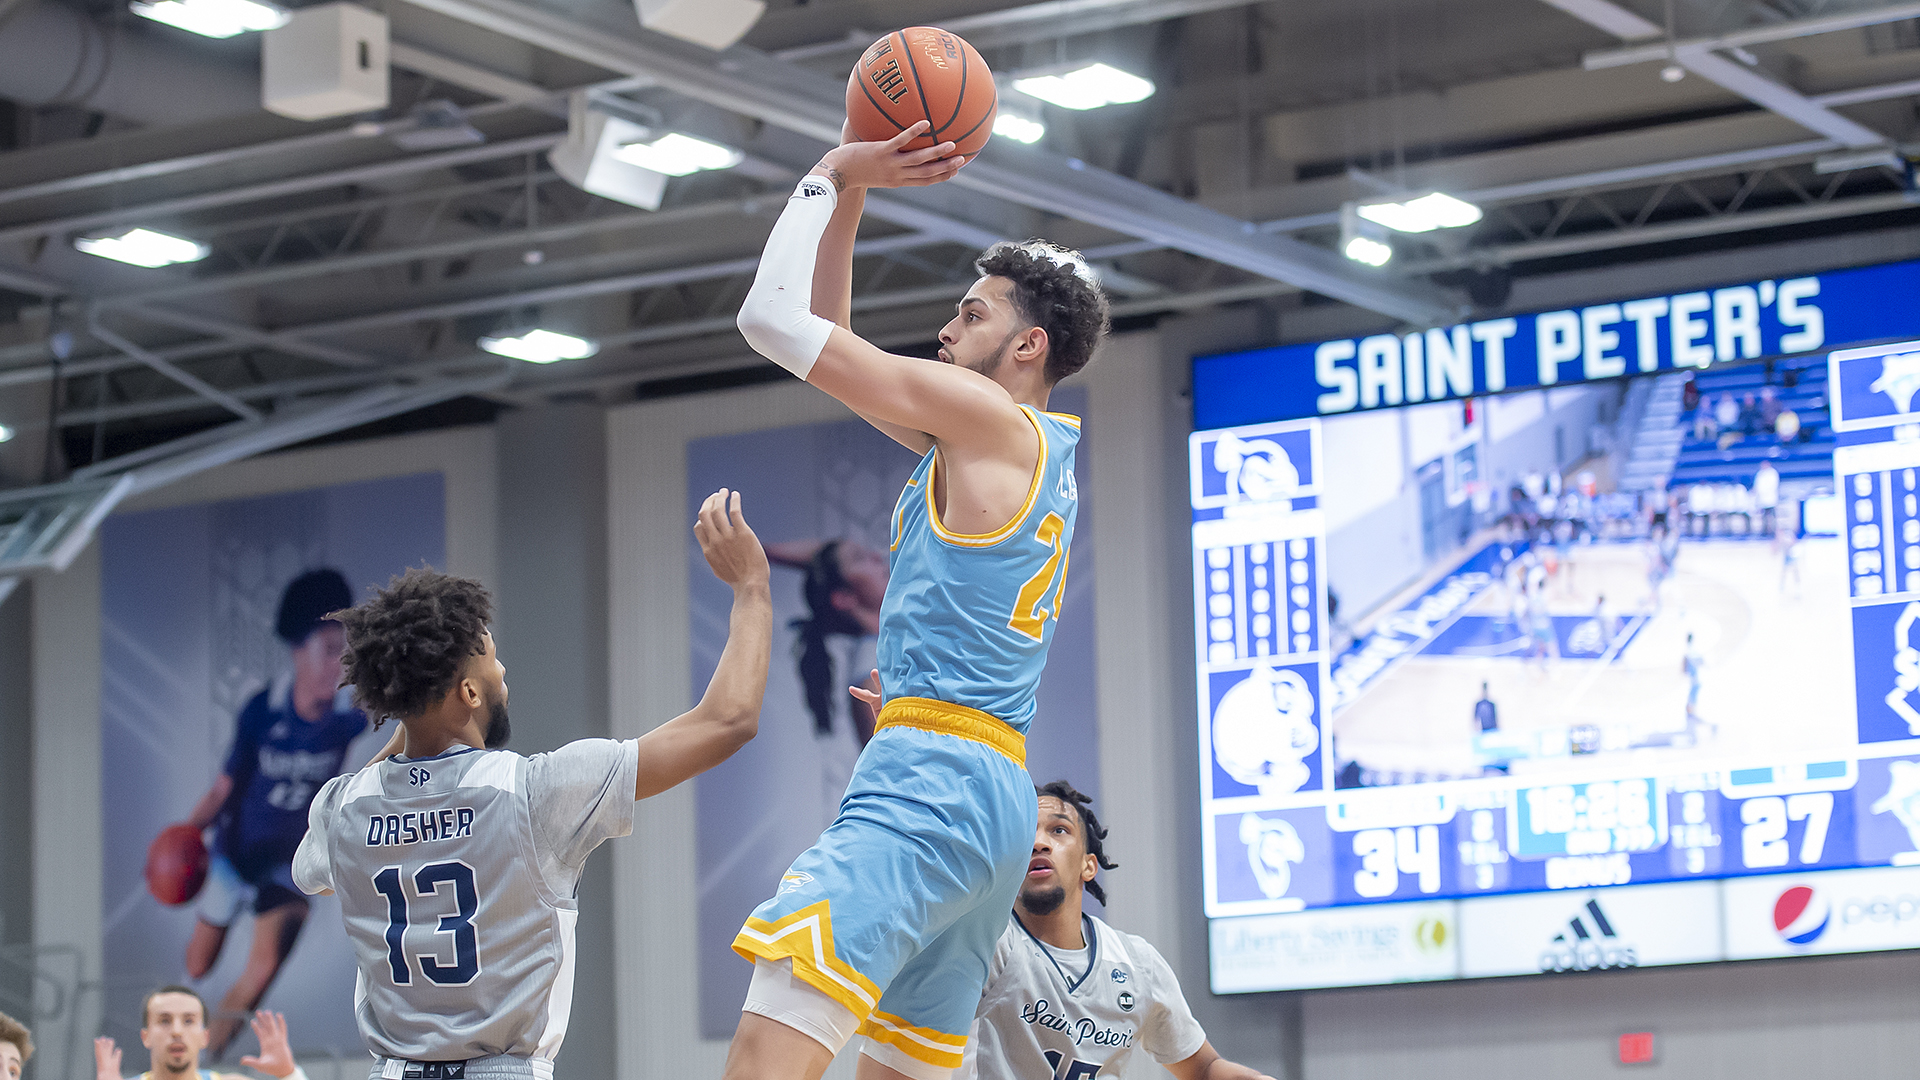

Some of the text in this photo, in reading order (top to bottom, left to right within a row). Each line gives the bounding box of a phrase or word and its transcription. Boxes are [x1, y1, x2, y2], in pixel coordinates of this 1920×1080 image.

[870, 58, 908, 105] THE
[1314, 276, 1826, 415] SAINT PETER'S
[1006, 510, 1071, 644] 2
[409, 765, 431, 789] SP
[365, 807, 475, 847] DASHER
[1740, 791, 1835, 869] 27
[1352, 824, 1442, 898] 34
[371, 858, 483, 988] 13
[1842, 894, 1920, 932] pep
[1539, 940, 1638, 974] adidas
